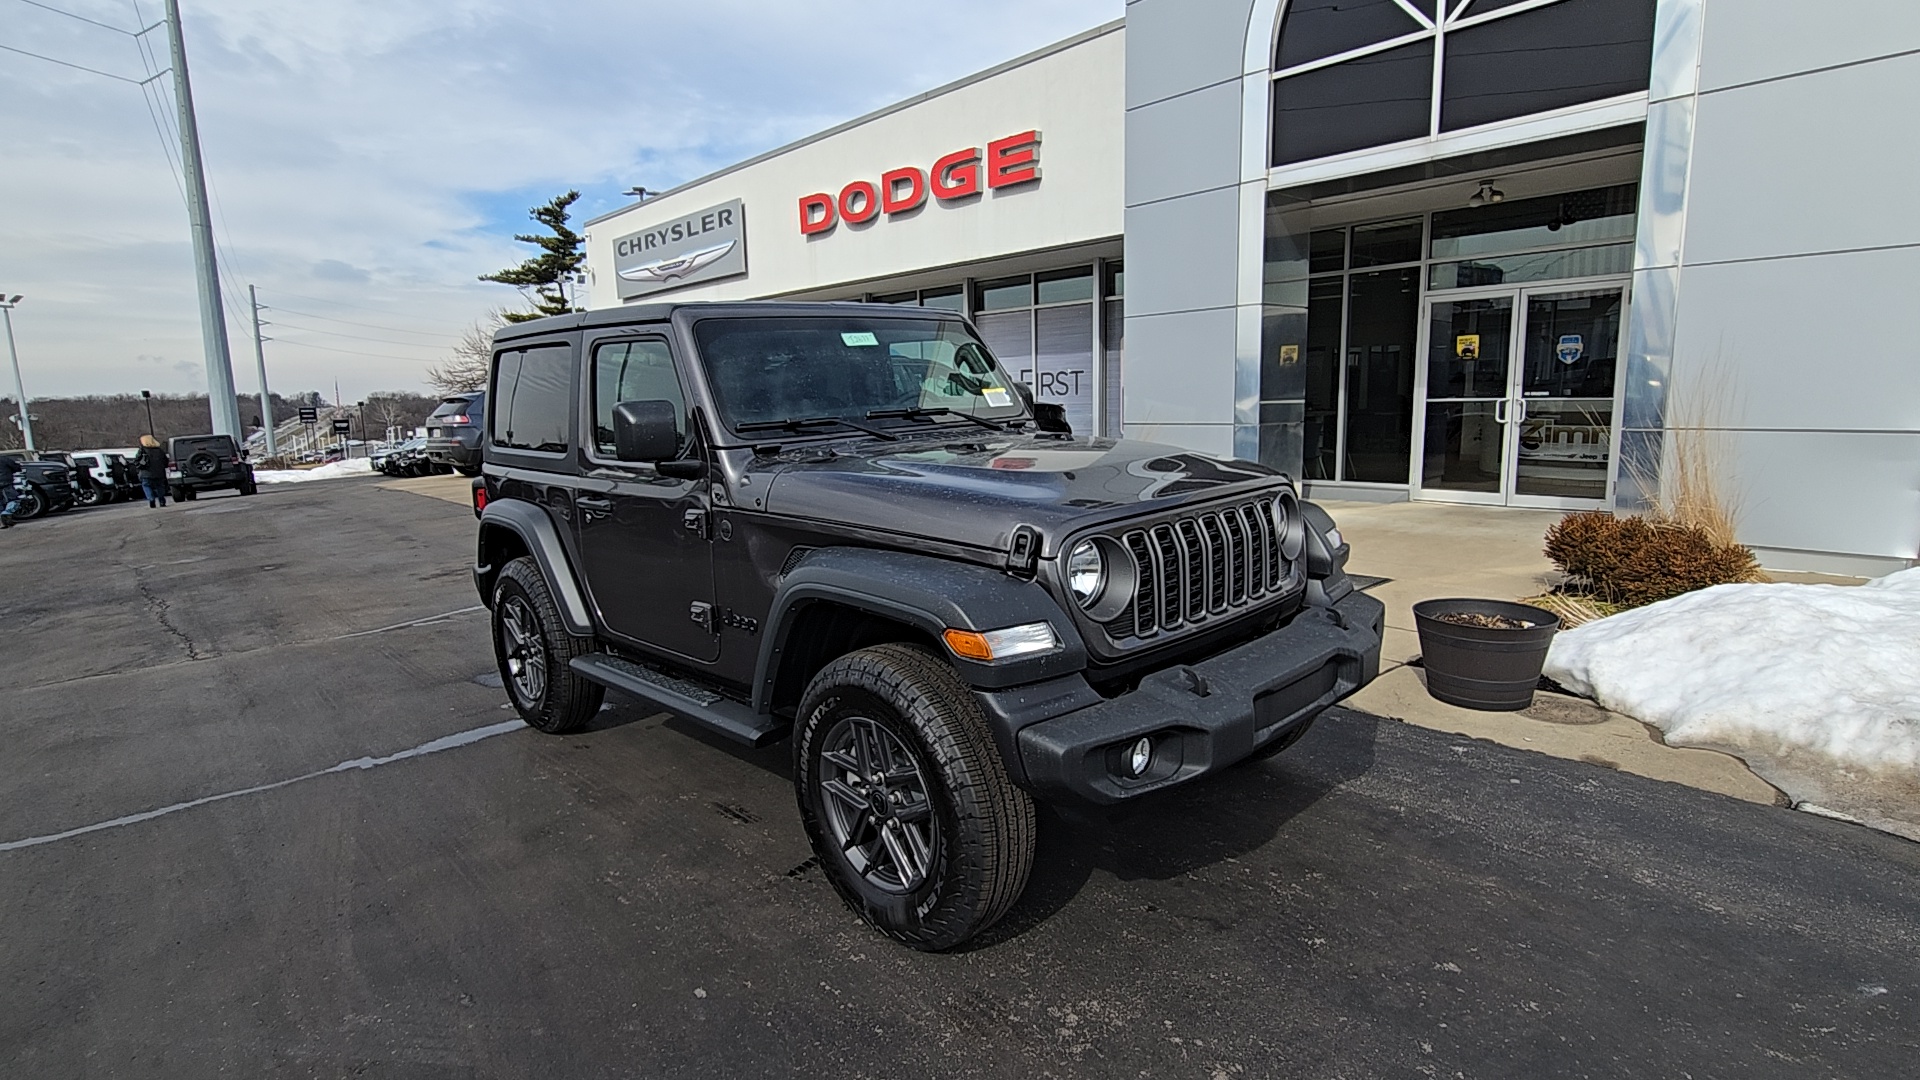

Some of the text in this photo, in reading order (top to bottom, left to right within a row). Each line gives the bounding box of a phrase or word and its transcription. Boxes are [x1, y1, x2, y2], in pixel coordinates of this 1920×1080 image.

[798, 130, 1041, 234] DODGE
[617, 208, 733, 258] CHRYSLER
[1020, 369, 1084, 396] FIRST
